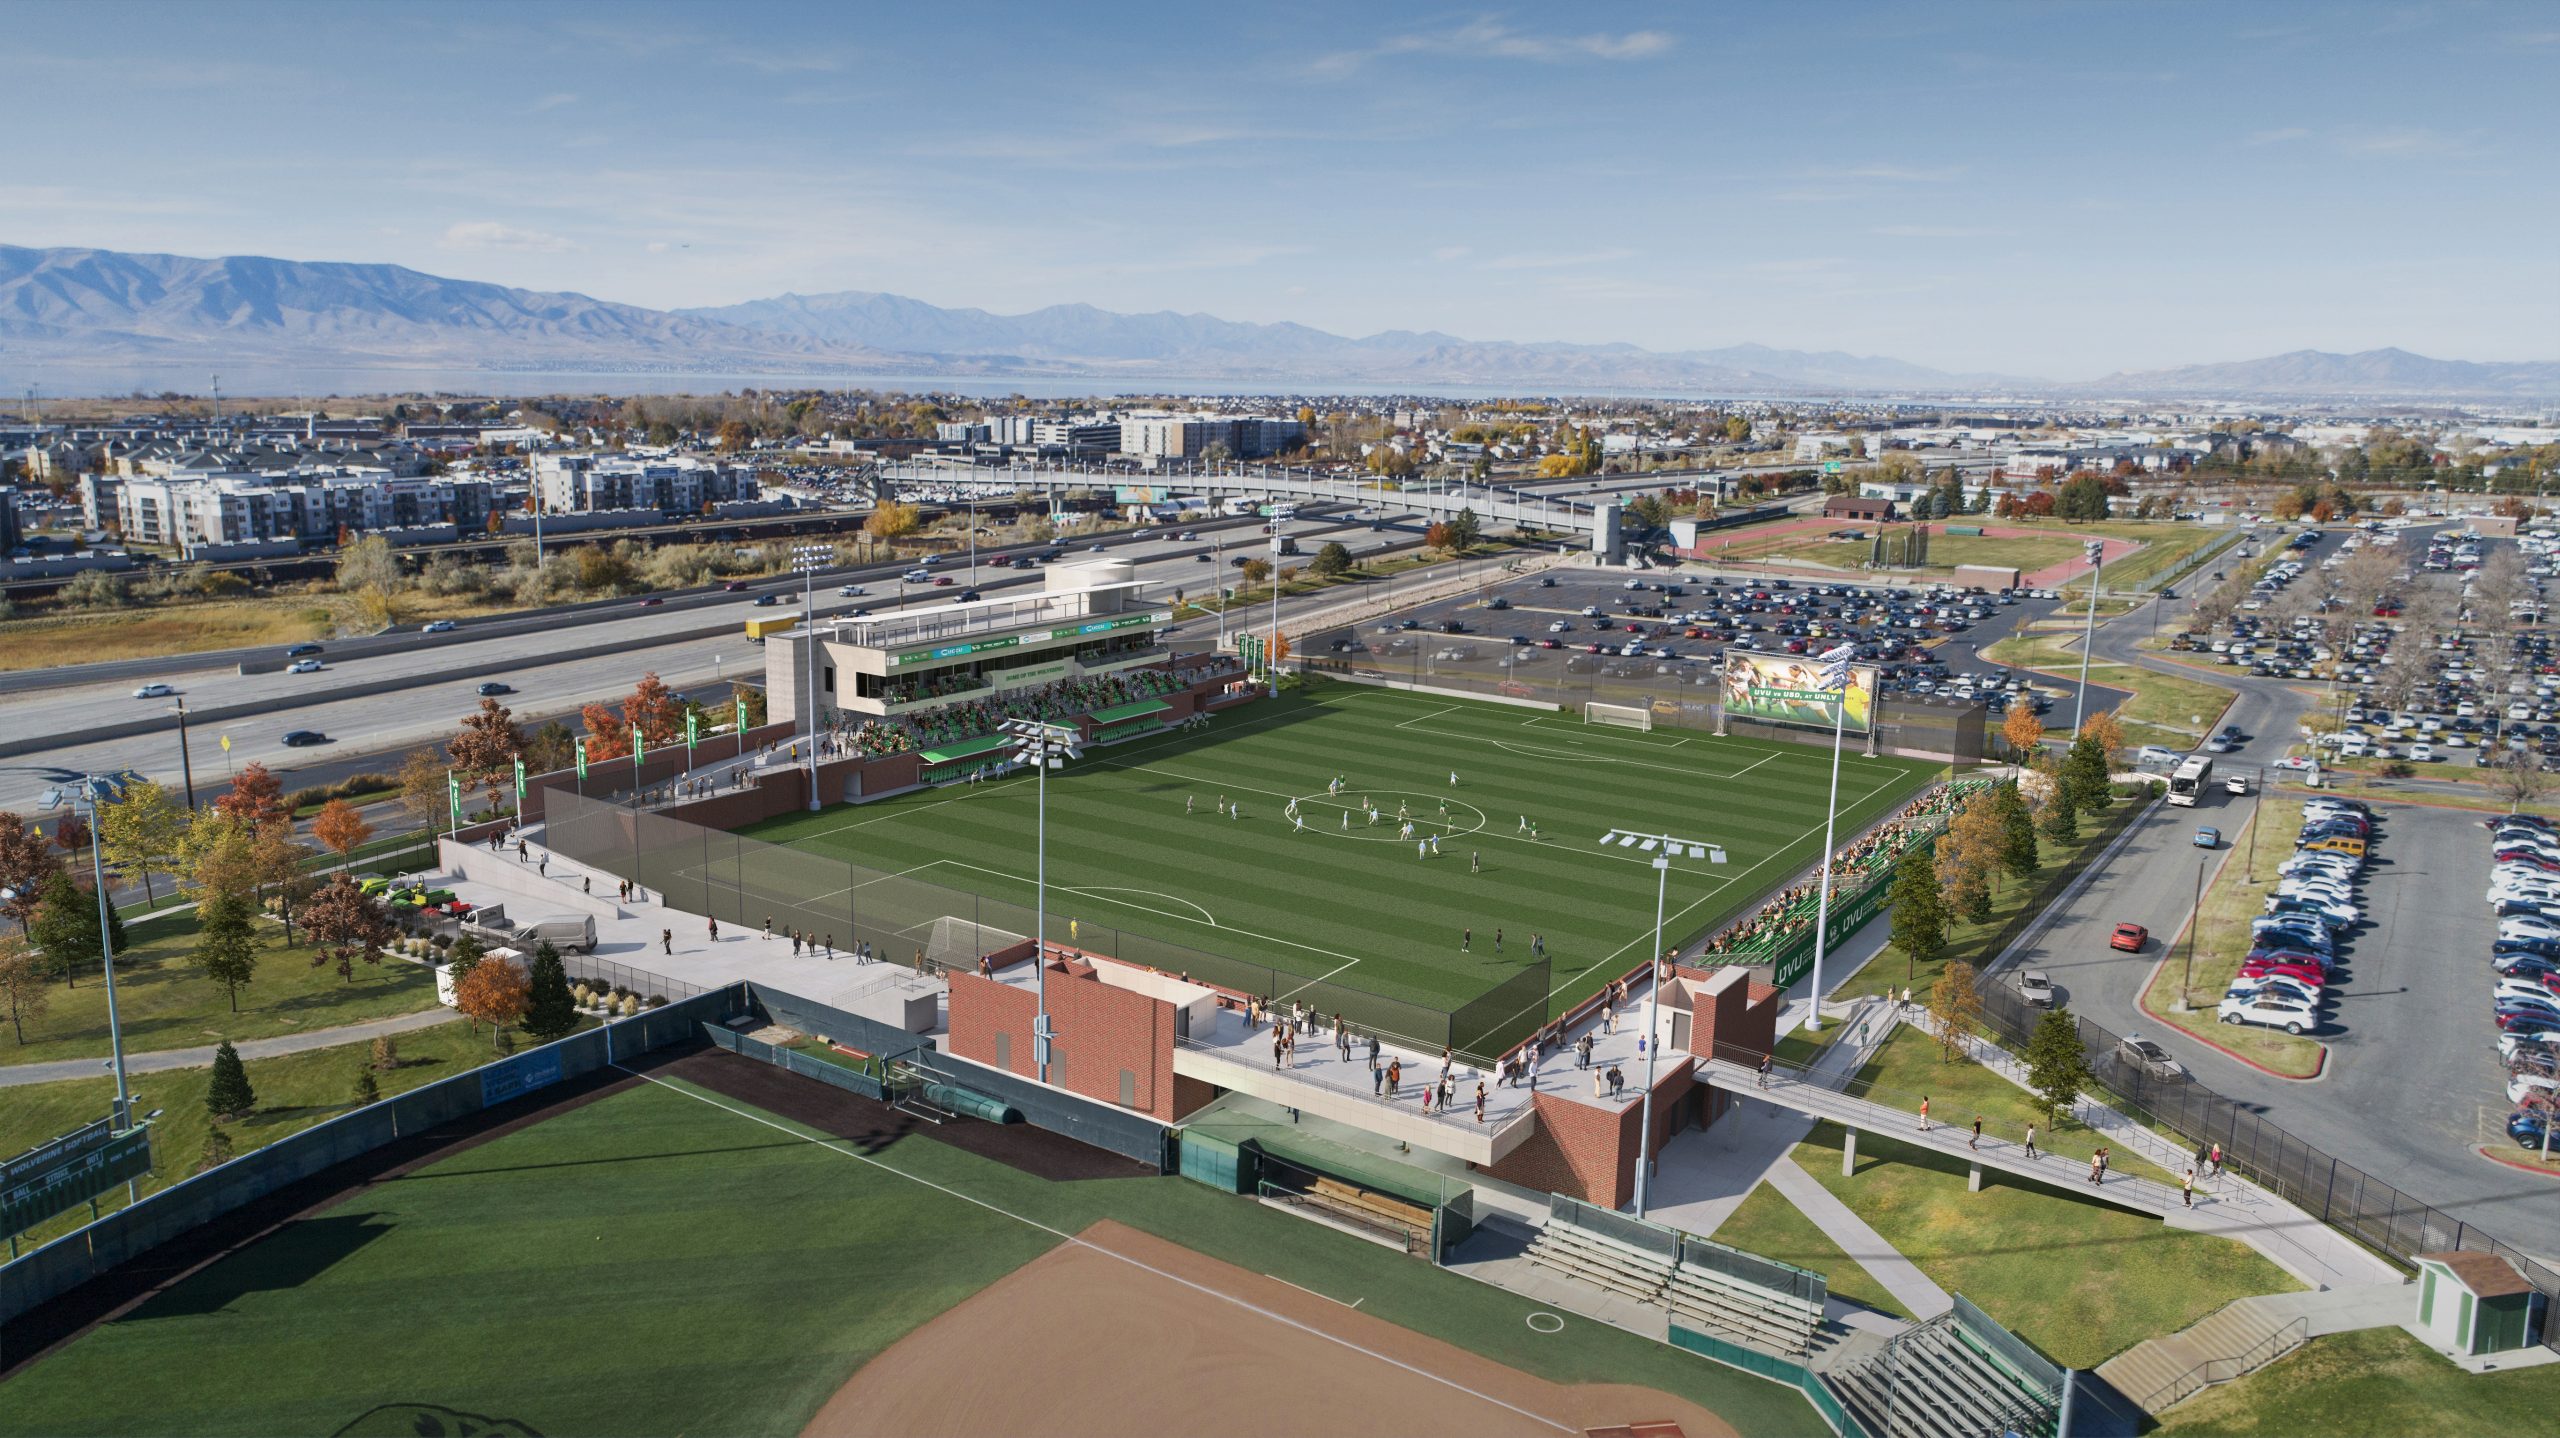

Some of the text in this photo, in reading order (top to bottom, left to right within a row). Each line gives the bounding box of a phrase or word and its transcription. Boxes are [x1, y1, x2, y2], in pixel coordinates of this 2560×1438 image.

[1814, 693, 1837, 701] UNLV
[1843, 905, 1863, 933] UVU
[1779, 952, 1803, 984] UVU
[10, 1126, 108, 1176] WOLVERINE SOFTBALL
[13, 1185, 30, 1199] BALL
